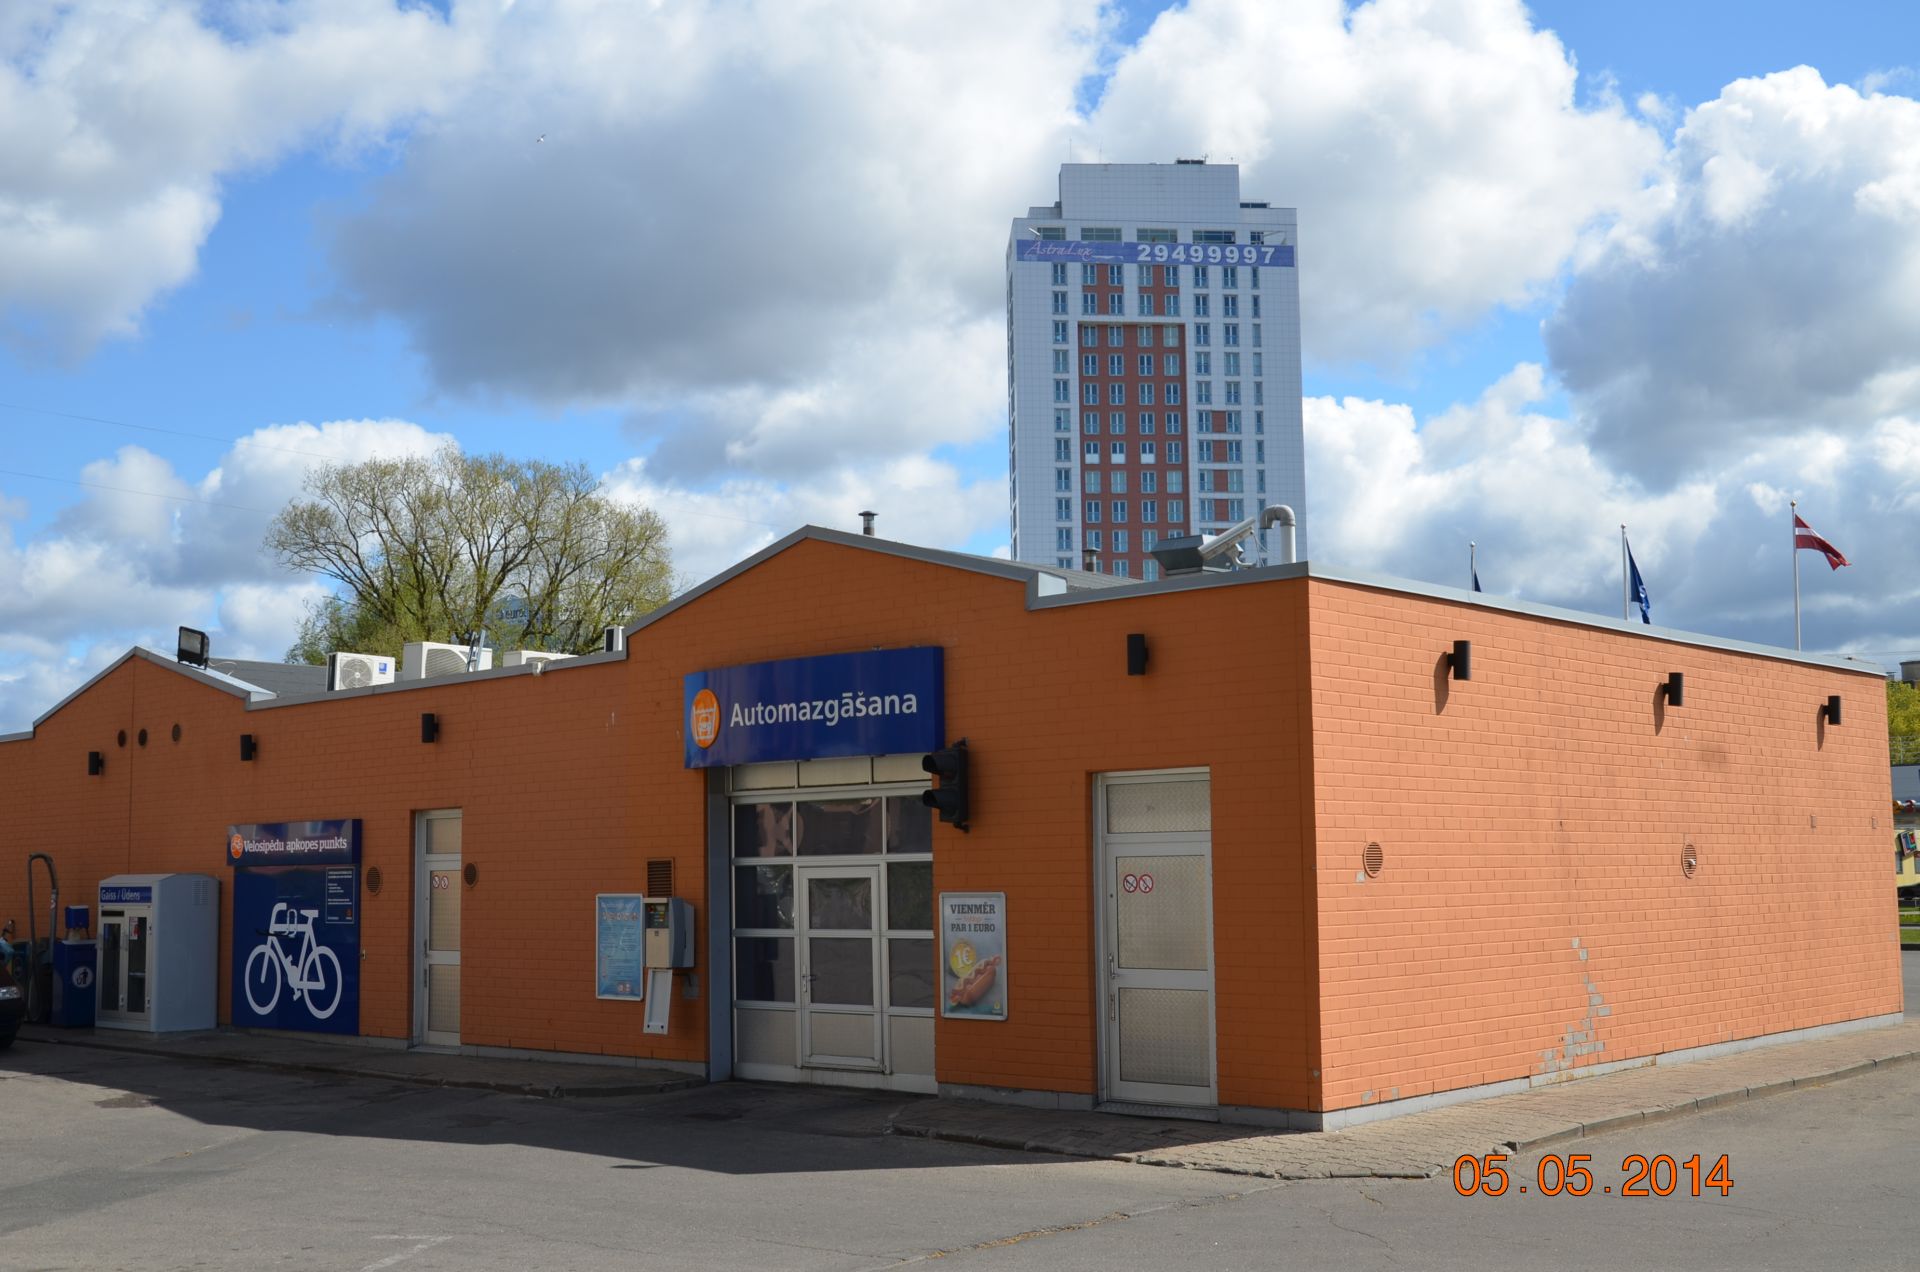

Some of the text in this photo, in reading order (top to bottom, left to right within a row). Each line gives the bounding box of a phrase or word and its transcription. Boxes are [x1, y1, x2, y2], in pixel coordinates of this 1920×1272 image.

[1137, 244, 1276, 264] 29499997
[730, 691, 917, 727] Automazgāšana
[244, 836, 347, 854] Velosipēdu apkopes punkts
[950, 902, 996, 914] VIENMĒR
[951, 923, 967, 932] PAR
[973, 923, 996, 932] EURO
